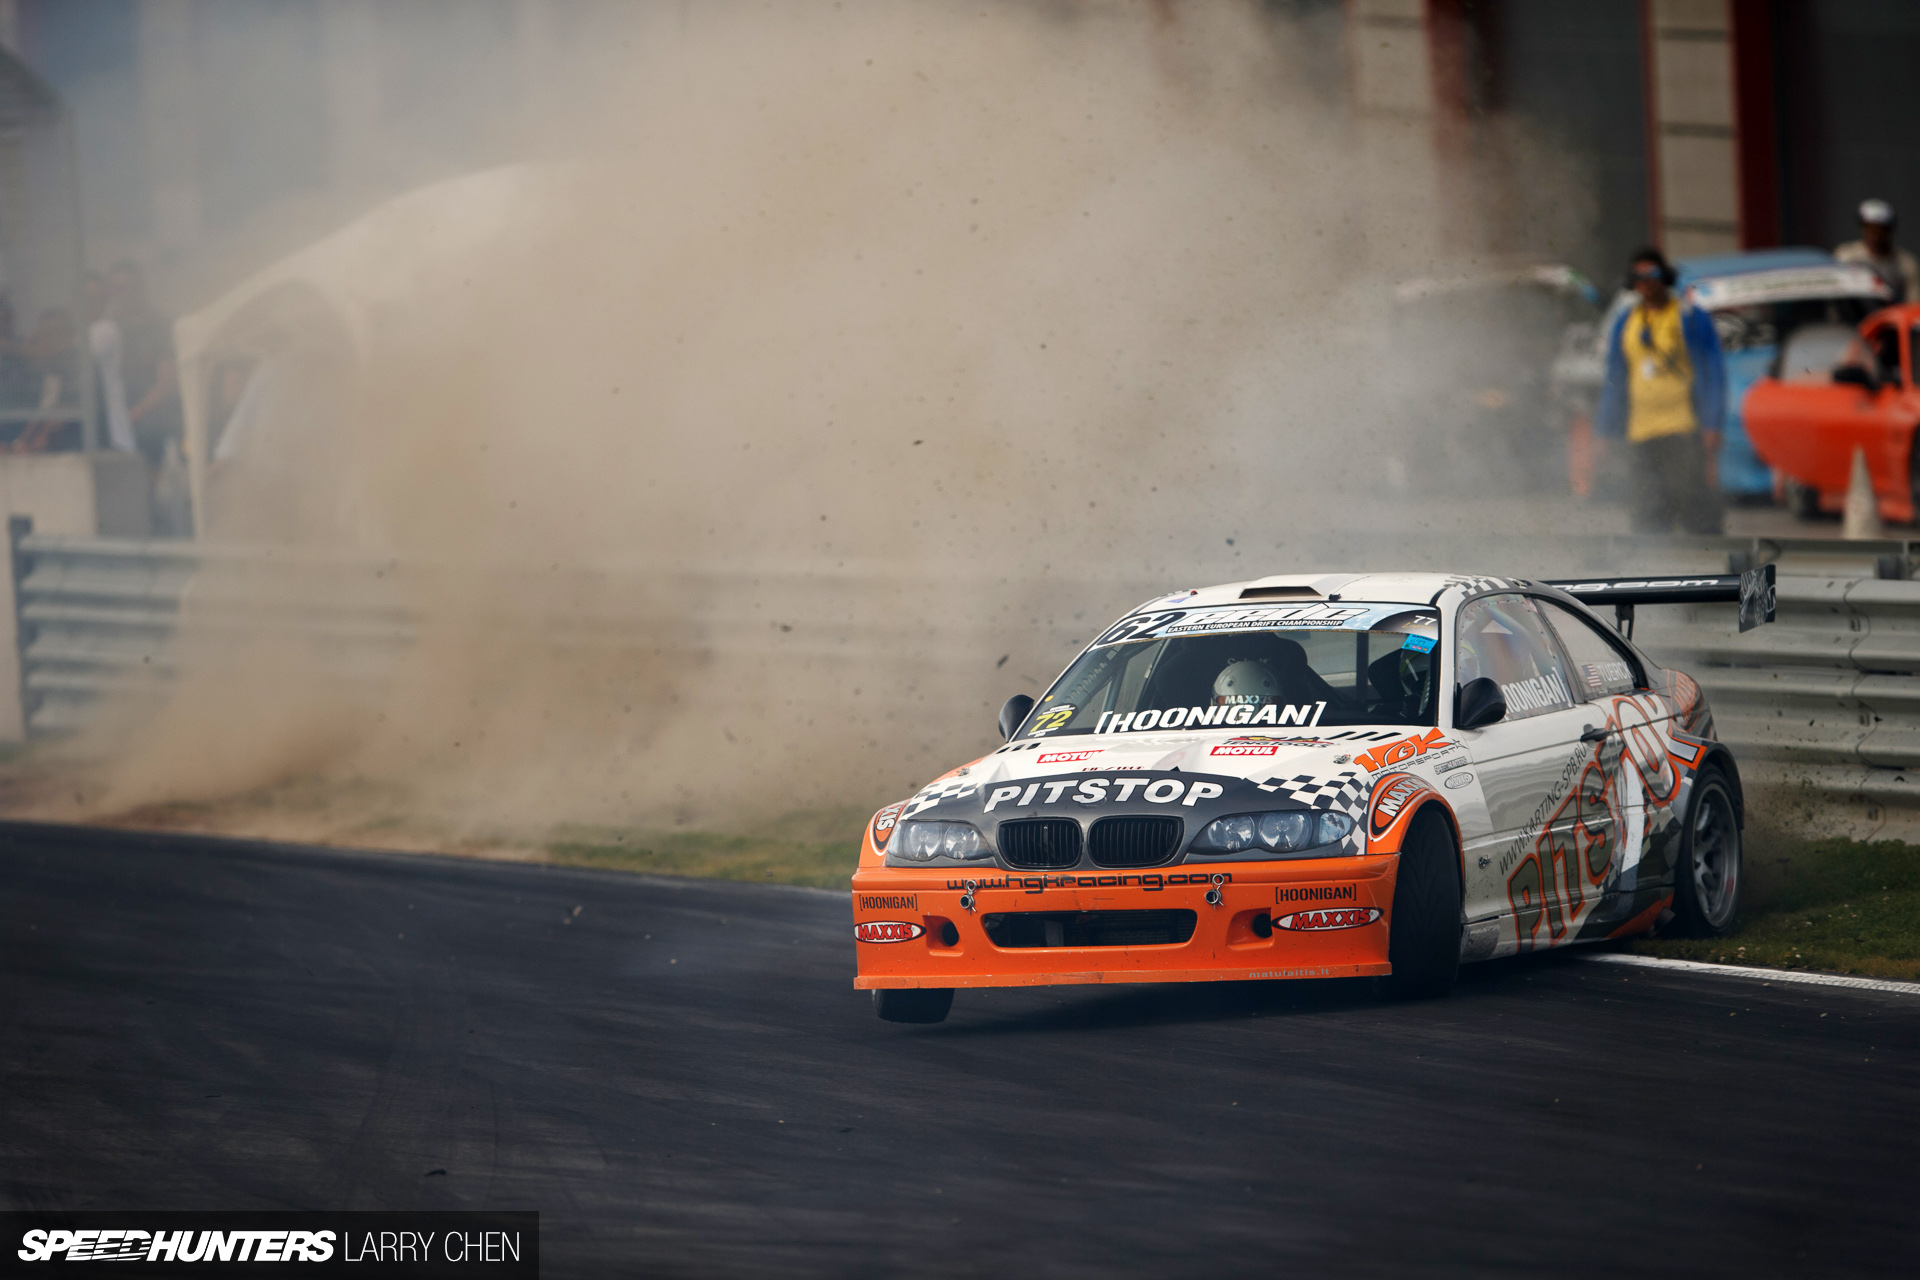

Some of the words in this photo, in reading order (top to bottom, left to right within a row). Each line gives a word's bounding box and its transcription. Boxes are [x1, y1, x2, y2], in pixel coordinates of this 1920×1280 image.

[1096, 611, 1187, 646] 62
[1167, 624, 1203, 634] EASTERN
[1205, 621, 1250, 630] EUROPEAN
[1251, 619, 1277, 628] DRIFT
[1276, 618, 1344, 627] CHAMPIONSHIP
[1413, 615, 1437, 626] 77
[1502, 666, 1573, 721] OONIGAN]
[1030, 710, 1073, 733] 72
[1093, 700, 1327, 734] [HOONIGAN]
[1213, 747, 1274, 755] MOTUL
[1353, 727, 1452, 773] HGK
[982, 775, 1225, 814] PITSTOP
[947, 872, 1233, 895] www.hgkracing.com
[1275, 884, 1357, 904] [HOONIGAN]
[858, 894, 918, 912] [HOONIGAN]
[1290, 909, 1371, 930] MAXXIS
[857, 923, 913, 941] MAXXIS
[1249, 968, 1330, 978] matulaitis.lt
